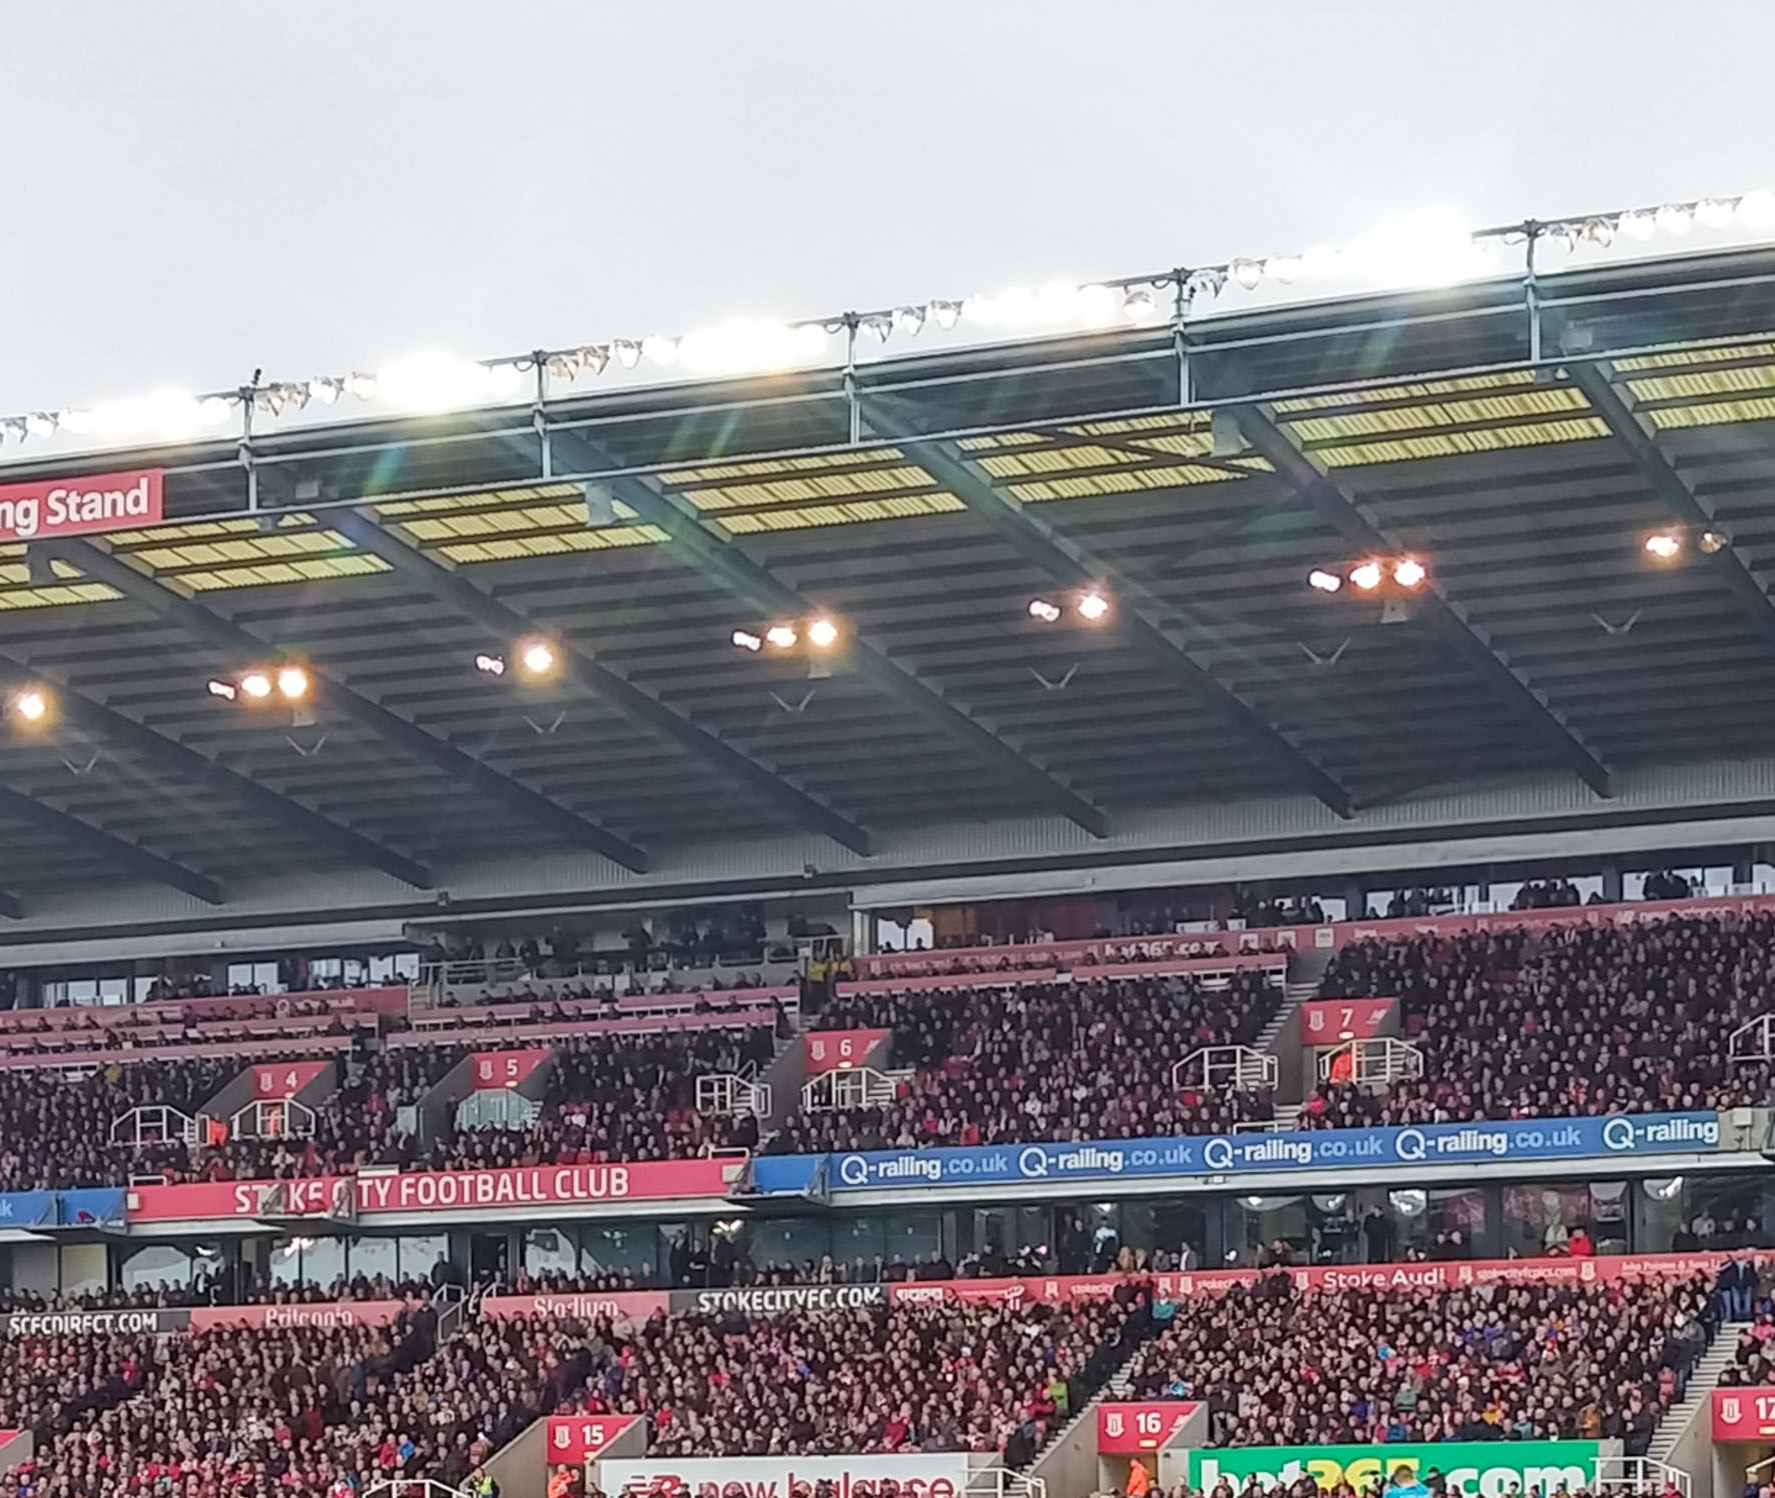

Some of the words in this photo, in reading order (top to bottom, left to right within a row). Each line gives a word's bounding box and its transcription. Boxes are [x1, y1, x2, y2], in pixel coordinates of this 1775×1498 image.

[46, 477, 149, 526] Stand
[1341, 1008, 1353, 1027] 7
[840, 1039, 852, 1056] 6
[285, 1070, 297, 1089] 4
[507, 1059, 518, 1076] 5
[1394, 1125, 1582, 1162] Q-railing.co.uk
[1603, 1116, 1719, 1151] Q-railing
[1019, 1144, 1193, 1178] Q-railing.co.uk
[1204, 1135, 1384, 1170] Q-railing.co.uk
[841, 1152, 1009, 1186] Q-railing.co.uk
[235, 1180, 324, 1214] STKE
[400, 1171, 547, 1206] FOOTBALL
[555, 1166, 629, 1199] CLUB
[1323, 1270, 1386, 1288] Stoke
[1392, 1267, 1446, 1286] Audi
[698, 1287, 881, 1312] STOKECITYFC.COM
[582, 1424, 604, 1446] 15
[1136, 1413, 1162, 1435] 16
